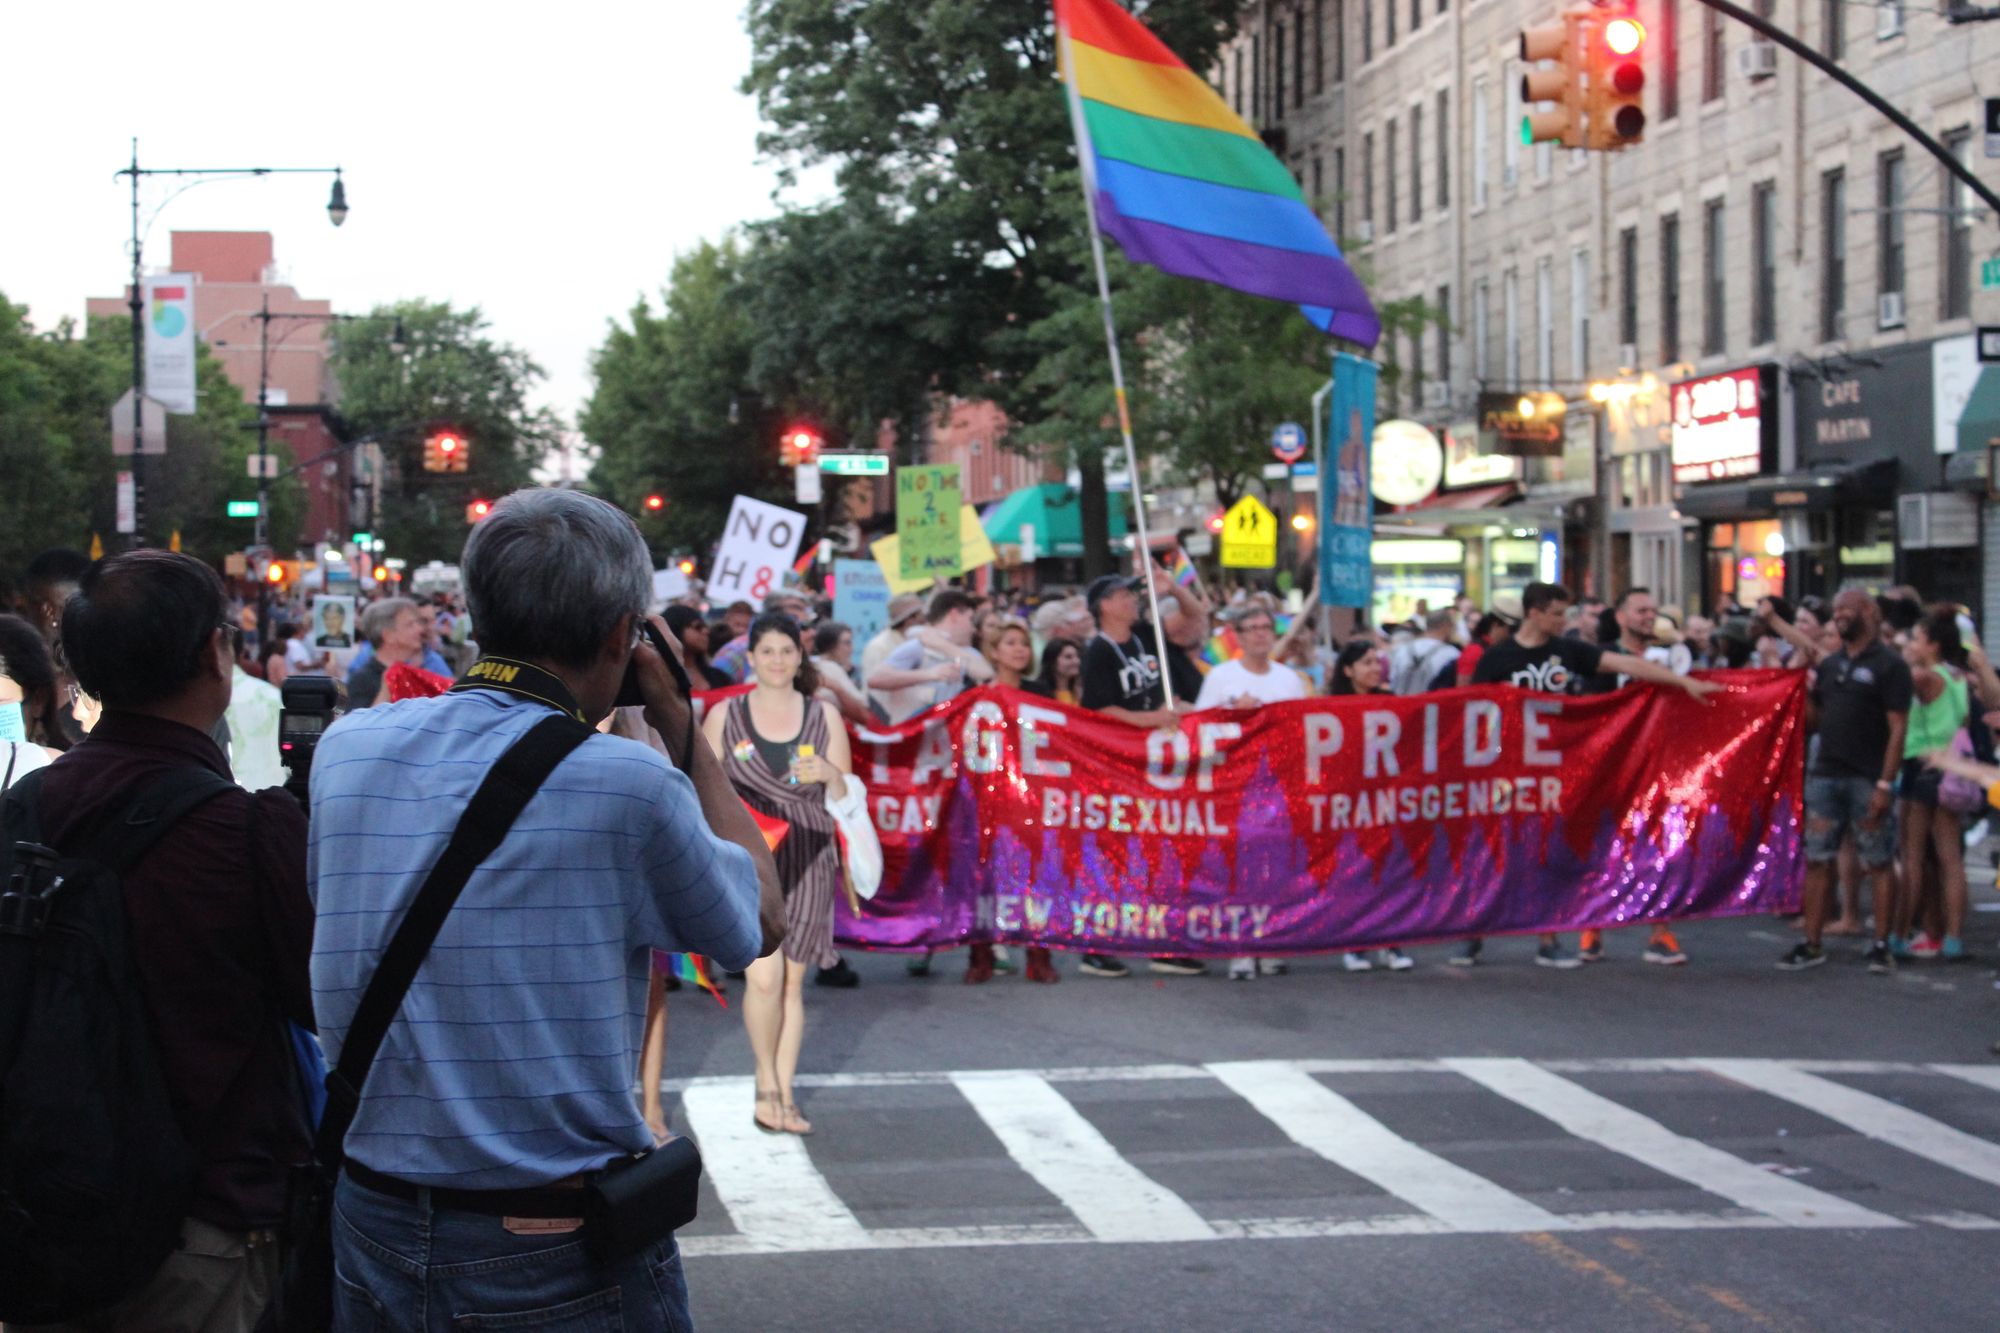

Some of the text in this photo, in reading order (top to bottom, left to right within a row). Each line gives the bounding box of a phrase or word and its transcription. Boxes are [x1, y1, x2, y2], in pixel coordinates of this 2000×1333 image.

[1817, 418, 1872, 445] MARTIN
[923, 491, 937, 512] 2
[732, 508, 793, 549] NO
[717, 556, 773, 600] H8
[1145, 722, 1242, 792] OF
[1303, 698, 1563, 785] PRIDE
[877, 776, 1562, 836] GAY BISEXUAL TRANSGENDER
[976, 896, 1272, 941] NEW YORK CITY
